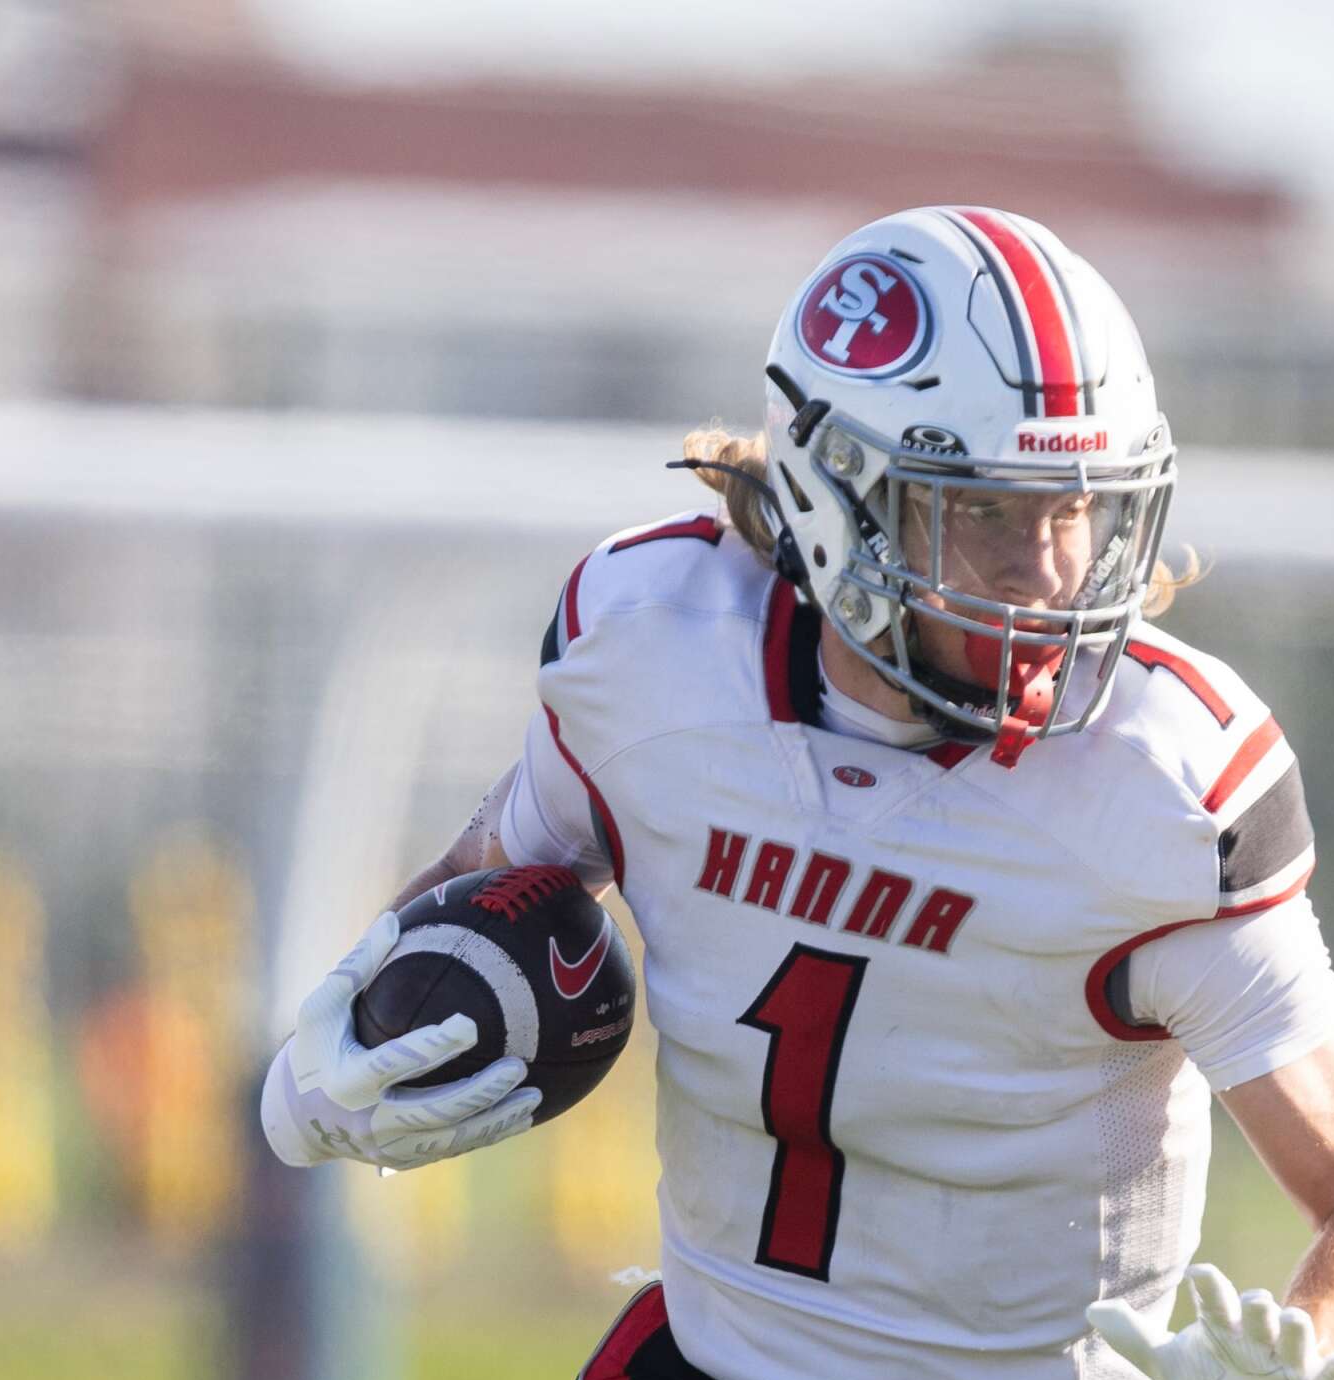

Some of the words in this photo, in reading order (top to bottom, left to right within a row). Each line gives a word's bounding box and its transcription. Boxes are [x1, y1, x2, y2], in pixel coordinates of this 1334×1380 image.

[1018, 432, 1107, 452] Riddell
[693, 825, 977, 955] HANNA
[735, 942, 870, 1282] 1
